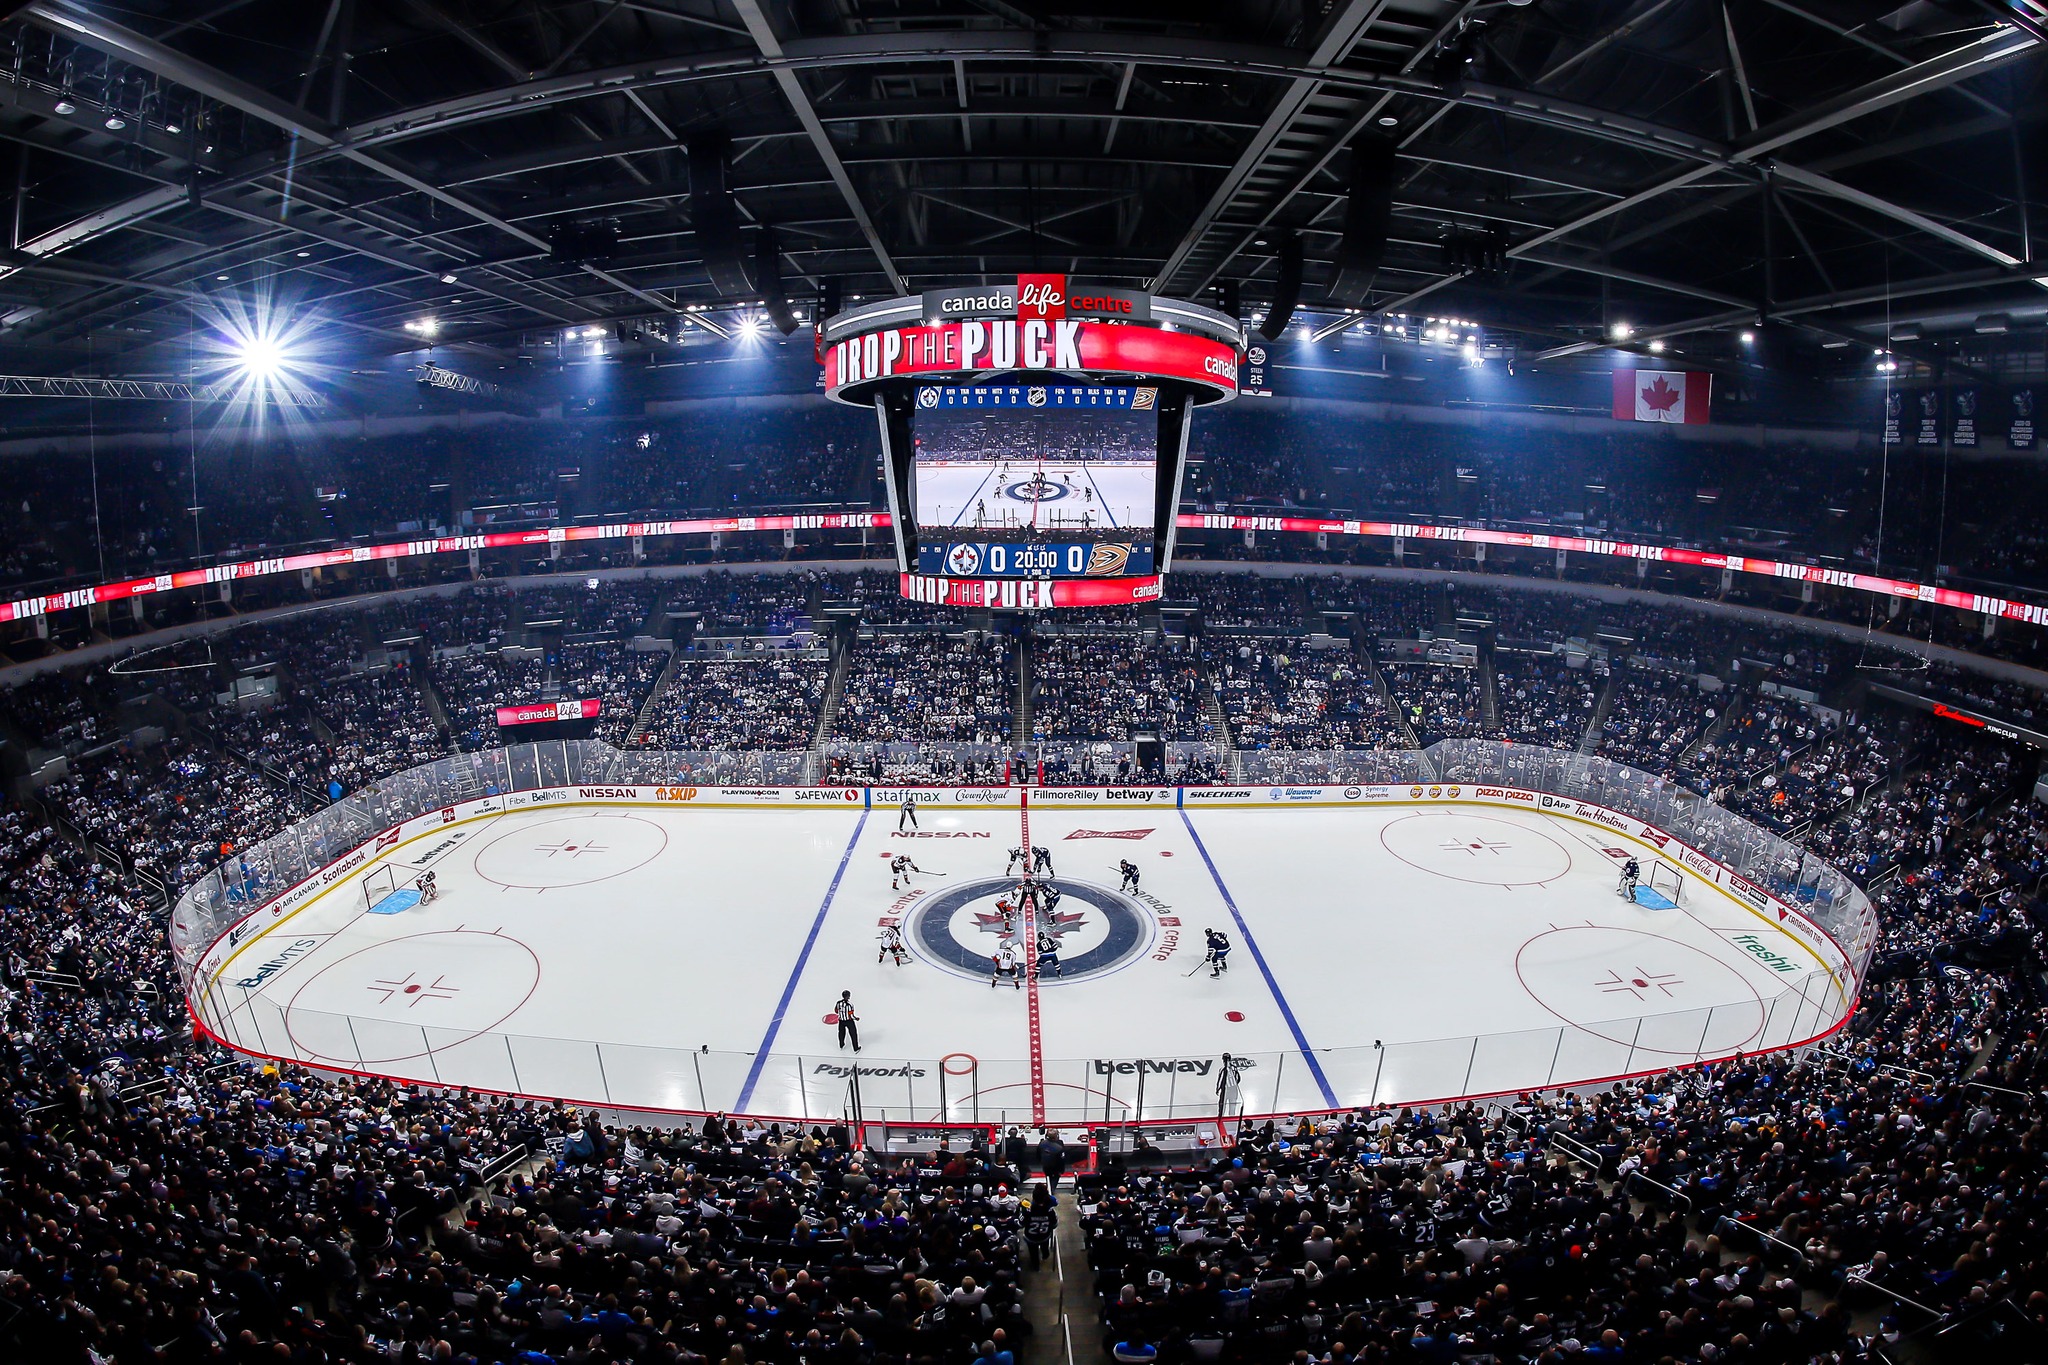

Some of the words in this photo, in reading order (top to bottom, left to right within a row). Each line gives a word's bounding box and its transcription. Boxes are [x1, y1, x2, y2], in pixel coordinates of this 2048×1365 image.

[942, 290, 1013, 312] canada
[1018, 278, 1066, 315] life
[1071, 295, 1132, 313] centre
[837, 330, 900, 386] DROP
[906, 329, 954, 367] THE
[961, 320, 1081, 369] PUCK
[1204, 354, 1237, 381] canada
[1250, 375, 1263, 384] 25
[598, 524, 628, 538] DROP
[628, 526, 643, 534] THE
[643, 522, 673, 536] PUCK
[793, 515, 824, 529] DROP
[824, 518, 841, 526] THE
[841, 514, 873, 528] PUCK
[1204, 516, 1236, 529] DROP
[1236, 518, 1252, 528] THE
[1251, 517, 1283, 531] PUCK
[1390, 524, 1420, 538] DROP
[1420, 528, 1435, 537] THE
[1434, 527, 1466, 541] PUCK
[408, 540, 439, 556] DROP
[439, 540, 455, 550] THE
[455, 536, 486, 550] PUCK
[1586, 539, 1616, 555] DROP
[1616, 544, 1632, 556] THE
[1632, 544, 1664, 562] PUCK
[990, 546, 1006, 572] 0
[1014, 552, 1058, 568] 20:00
[1068, 546, 1083, 572] 0
[206, 564, 238, 582] DROP
[238, 562, 254, 576] THE
[254, 558, 285, 576] PUCK
[1775, 562, 1806, 580] DROP
[1806, 568, 1823, 582] THE
[1823, 569, 1856, 588] PUCK
[908, 576, 948, 604] DROP
[952, 584, 981, 604] THE
[984, 581, 1055, 608] PUCK
[1132, 584, 1158, 599] canada
[12, 596, 47, 620] DROP
[47, 595, 64, 610] THE
[64, 588, 96, 610] PUCK
[1974, 594, 2007, 616] DROP
[2007, 603, 2024, 619] THE
[518, 708, 556, 721] canada
[557, 701, 581, 717] life
[1988, 724, 2002, 735] KING
[2002, 729, 2018, 739] CLUB
[532, 790, 566, 802] BellMTS
[580, 788, 636, 798] NISSAN
[668, 788, 697, 800] SKIP
[795, 790, 844, 800] SAFEWAY
[876, 790, 940, 802] staffmax
[955, 789, 982, 802] Crown
[981, 789, 1010, 803] Royal
[1033, 790, 1099, 801] FillmoreRiley
[1106, 789, 1154, 802] betway
[1285, 788, 1322, 796] Wawanesa
[1365, 786, 1389, 794] Synergy
[1476, 788, 1504, 798] pizza
[1504, 790, 1534, 802] pizza
[509, 796, 526, 806] Fibe
[1553, 800, 1570, 810] App
[424, 816, 442, 826] canada
[1574, 804, 1592, 818] Tim
[1592, 808, 1628, 831] Hortons
[1644, 828, 1667, 846] Budweiser
[412, 840, 456, 864] betway
[322, 851, 366, 885] Scotiabank
[1732, 877, 1747, 891] TSN
[282, 897, 294, 908] AIR
[294, 880, 320, 902] CANADA
[887, 889, 926, 915] centre
[1788, 914, 1814, 938] CANADIAN
[1812, 930, 1824, 946] TIRE
[1042, 940, 1052, 951] 81
[1152, 930, 1178, 962] centre
[1732, 934, 1802, 973] freshii
[236, 939, 316, 988] BellMTS
[1002, 952, 1012, 961] 19
[814, 1064, 926, 1078] Payworks
[1094, 1059, 1213, 1076] betway
[1486, 1194, 1510, 1215] 27
[1414, 1224, 1435, 1243] 23
